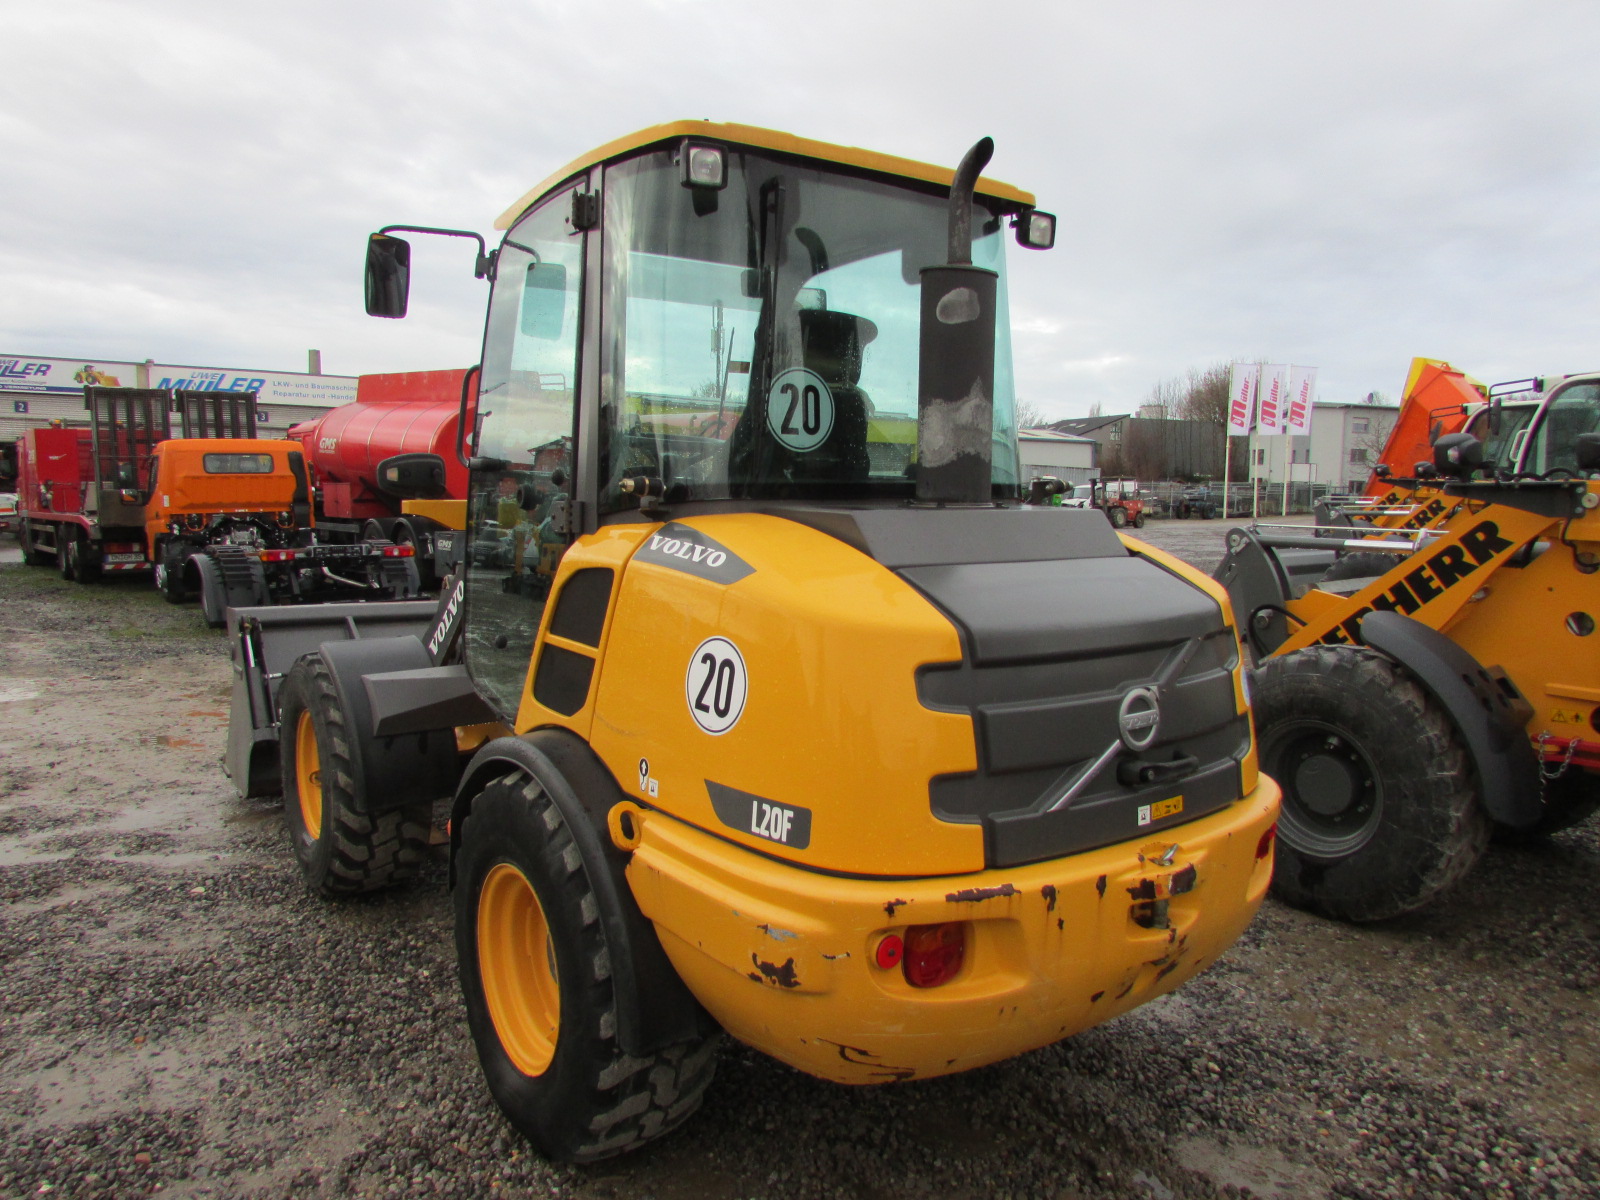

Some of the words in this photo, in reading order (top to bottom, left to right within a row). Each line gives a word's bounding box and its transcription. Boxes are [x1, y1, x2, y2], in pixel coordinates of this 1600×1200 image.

[191, 372, 221, 380] UWE
[273, 390, 310, 399] Reparatur
[18, 402, 25, 411] 2
[780, 383, 820, 435] 20
[319, 438, 336, 450] GMS
[438, 539, 453, 549] GMS
[649, 534, 727, 568] VOLVO
[428, 580, 464, 655] VOLVO
[694, 652, 736, 718] 20
[751, 800, 794, 843] L20F
